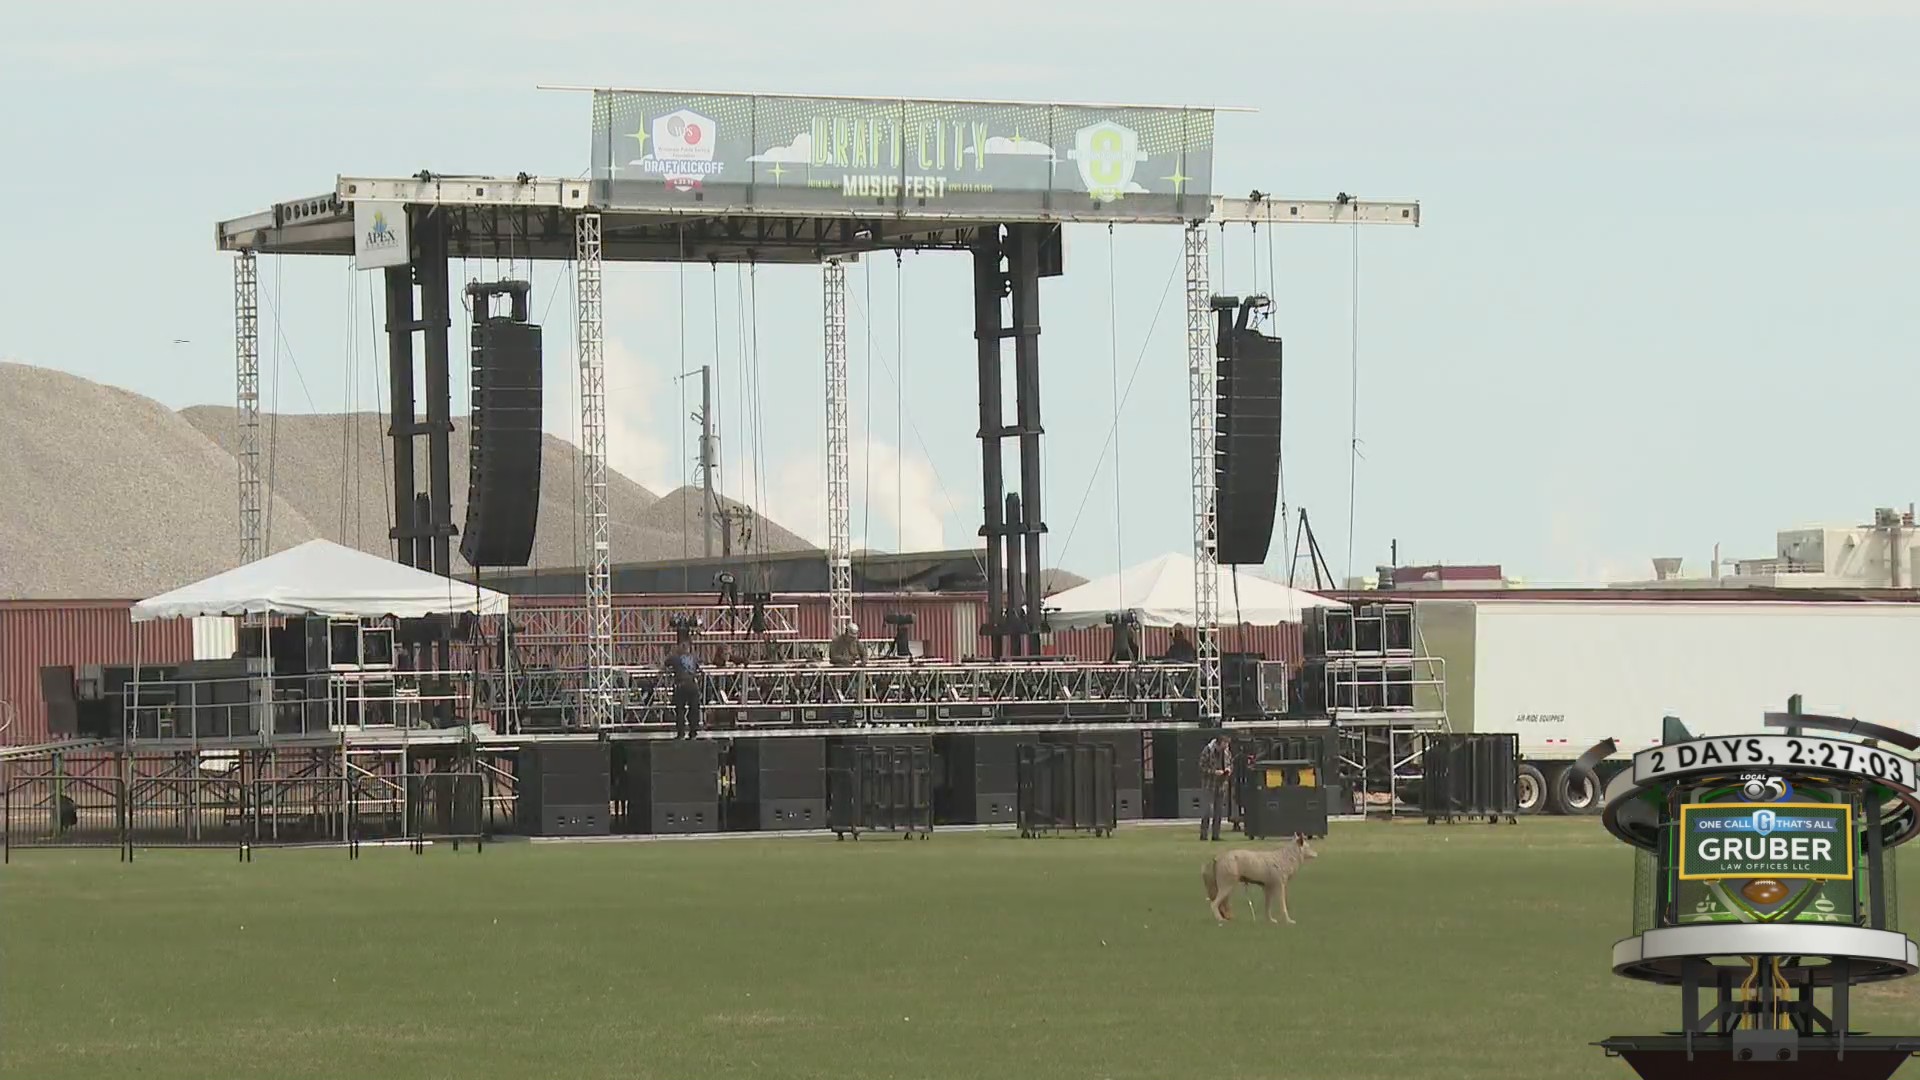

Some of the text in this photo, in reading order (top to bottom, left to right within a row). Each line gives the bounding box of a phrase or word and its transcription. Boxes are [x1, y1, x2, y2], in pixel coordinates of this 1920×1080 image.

[812, 115, 988, 171] DRAFT CITY
[644, 160, 725, 174] DRAFT KICKOFF
[842, 174, 899, 197] MUSIC
[904, 175, 947, 198] FEST
